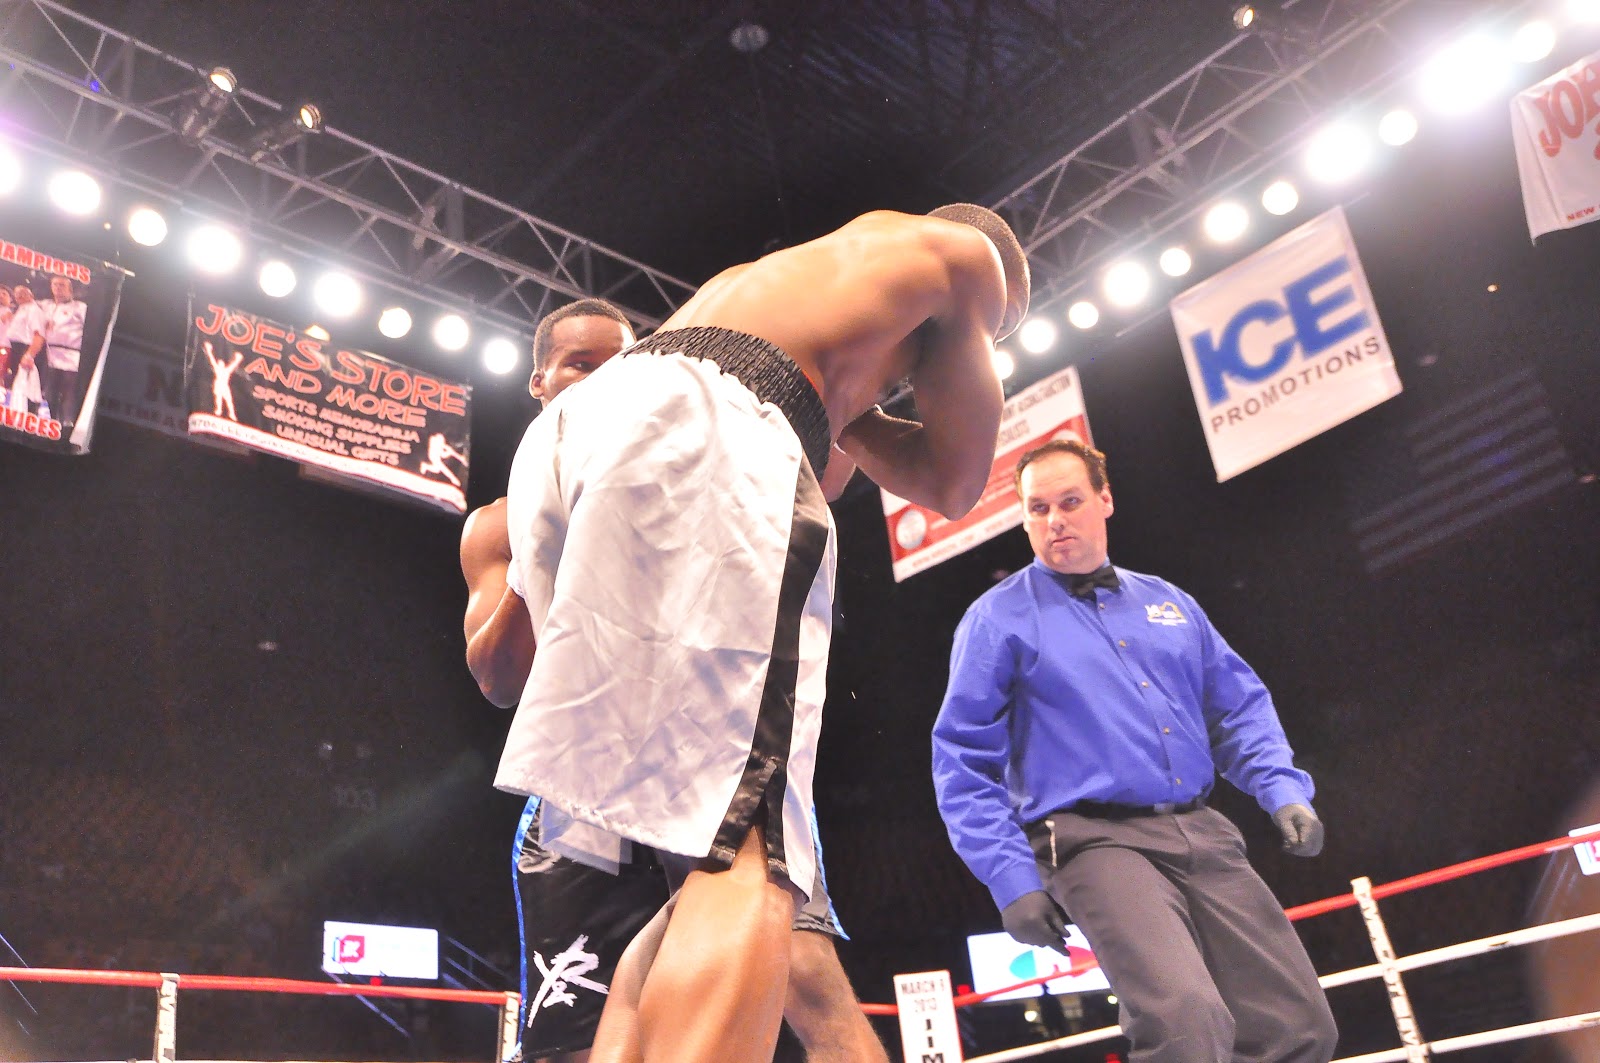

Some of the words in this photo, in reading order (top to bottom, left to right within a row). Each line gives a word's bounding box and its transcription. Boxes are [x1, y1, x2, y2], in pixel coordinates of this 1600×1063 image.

[1566, 206, 1595, 221] NEW
[196, 304, 322, 371] JOE'S
[331, 351, 467, 416] STORE
[1190, 254, 1372, 408] ICE
[244, 357, 322, 394] AND
[326, 385, 427, 427] MORE
[252, 385, 318, 416] SPORTS
[1211, 336, 1381, 433] PROMOTIONS
[261, 405, 333, 438] SMOKING
[335, 427, 412, 454] SUPPLIES
